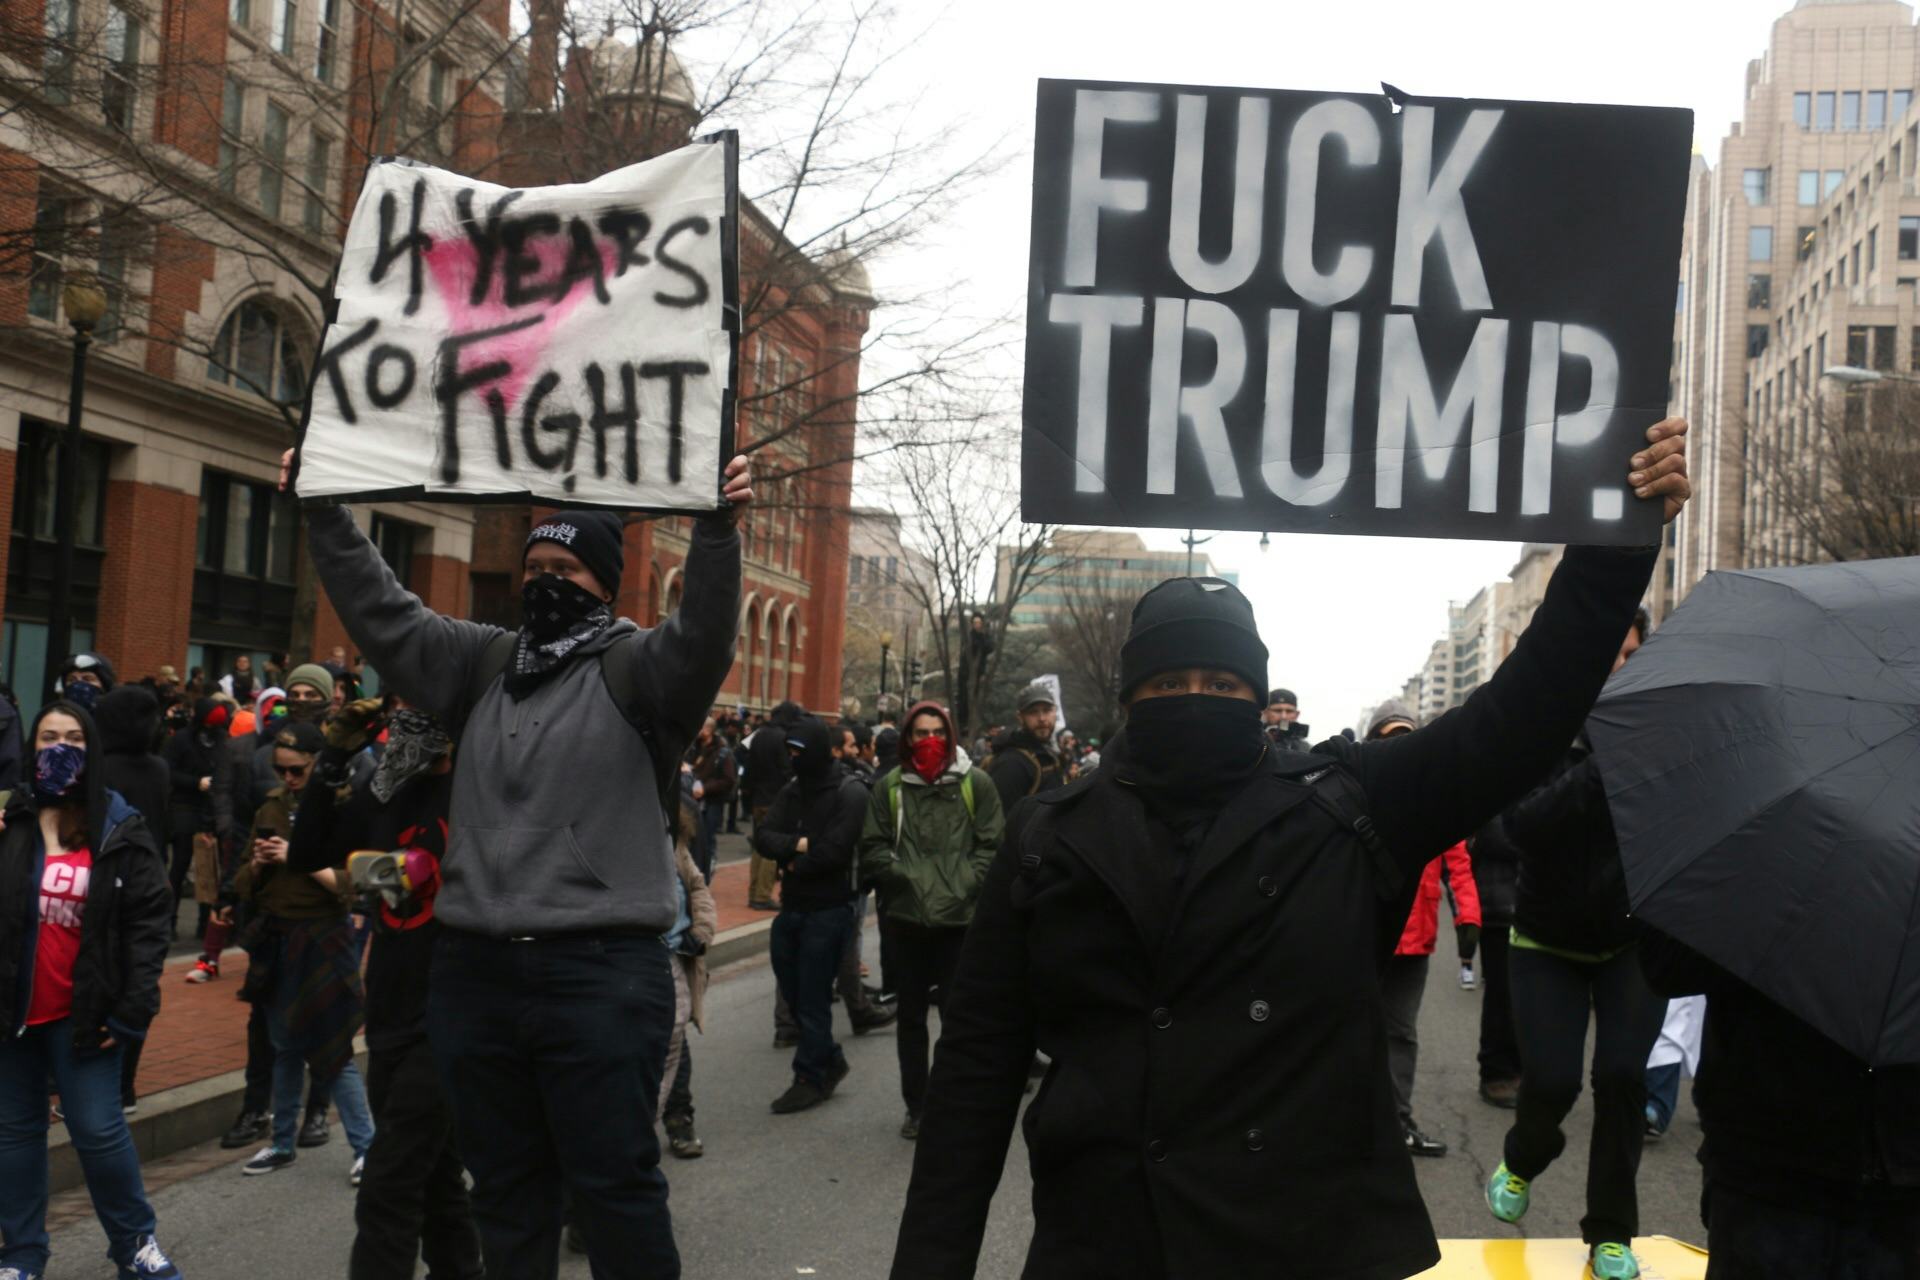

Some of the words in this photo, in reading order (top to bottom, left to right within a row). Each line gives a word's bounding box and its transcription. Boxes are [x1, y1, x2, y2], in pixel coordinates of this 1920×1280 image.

[369, 177, 433, 316] 4
[457, 187, 711, 309] YEARS
[1062, 88, 1505, 311] FUCK
[316, 316, 417, 424] TO
[434, 314, 710, 491] FIGHT
[1048, 294, 1625, 521] TRUMP.
